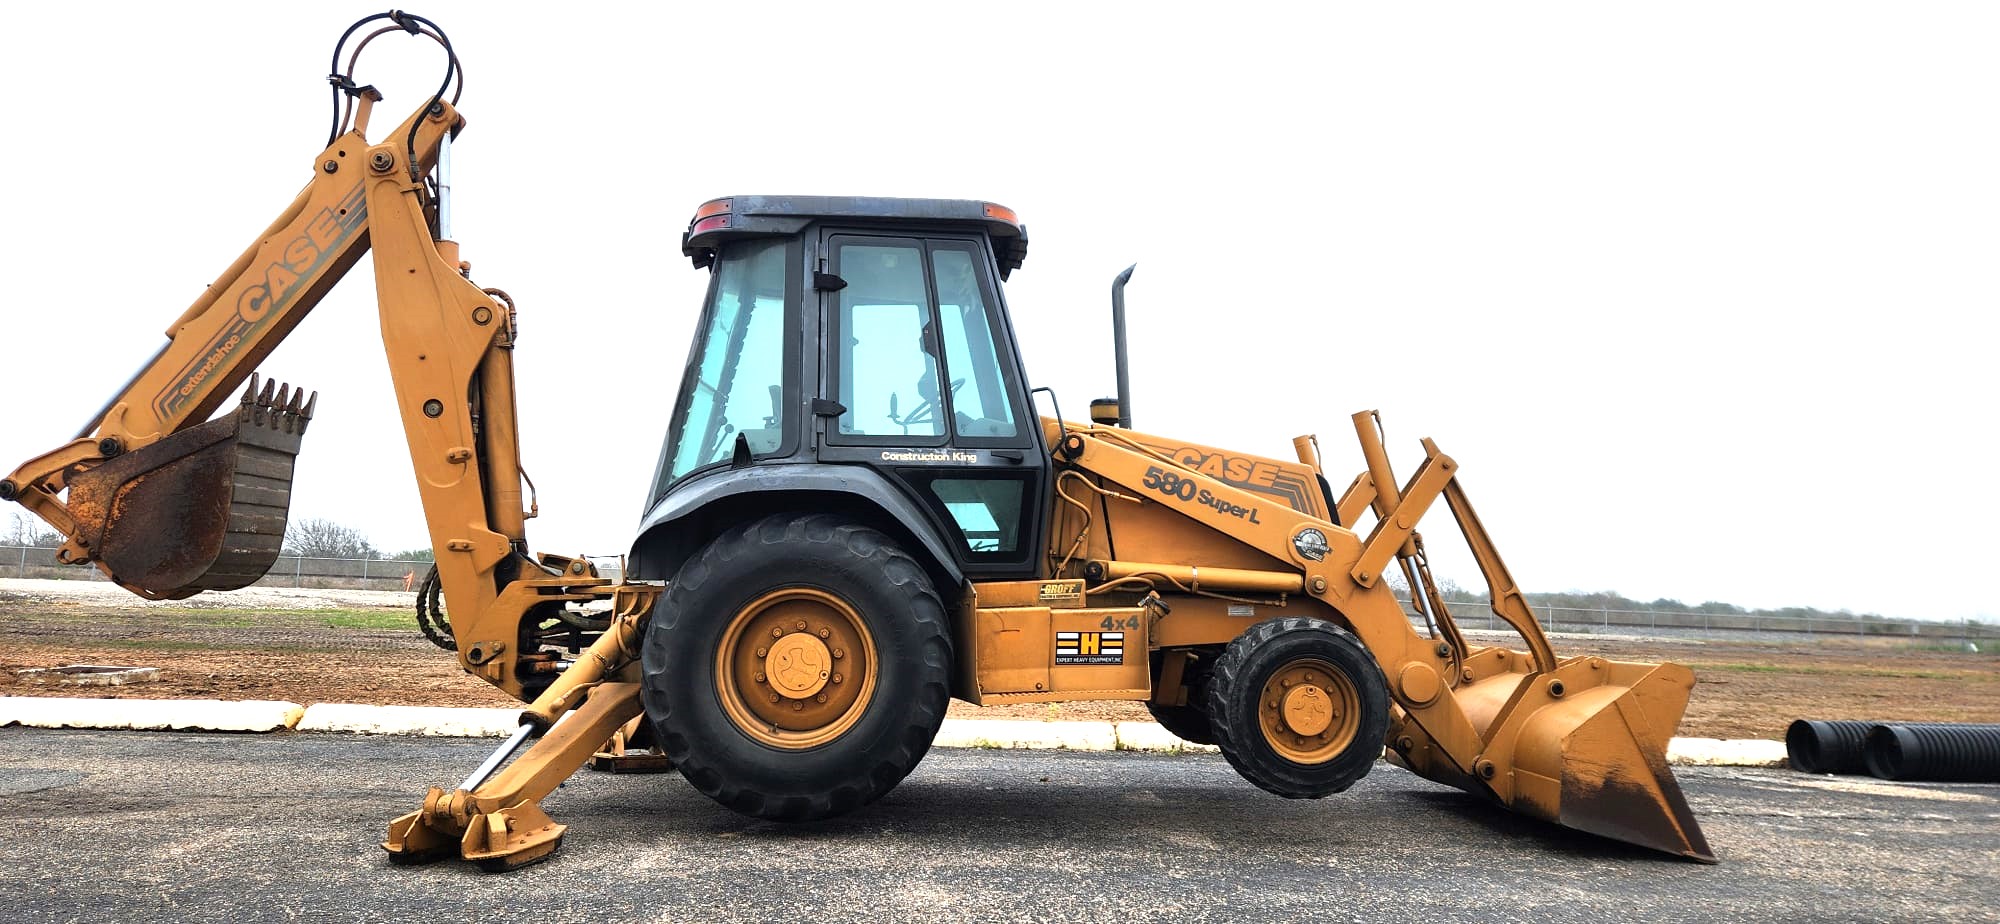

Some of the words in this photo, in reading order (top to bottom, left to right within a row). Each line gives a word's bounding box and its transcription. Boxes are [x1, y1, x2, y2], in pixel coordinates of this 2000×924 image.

[237, 207, 344, 323] CASE
[180, 333, 241, 395] extendahoe
[881, 451, 949, 461] Construction
[952, 452, 977, 463] King
[1172, 447, 1281, 488] CASE
[1142, 465, 1197, 502] 580
[1198, 489, 1250, 519] Super
[1249, 508, 1260, 525] L
[1045, 584, 1076, 594] GROFF
[1100, 615, 1139, 631] 4x4
